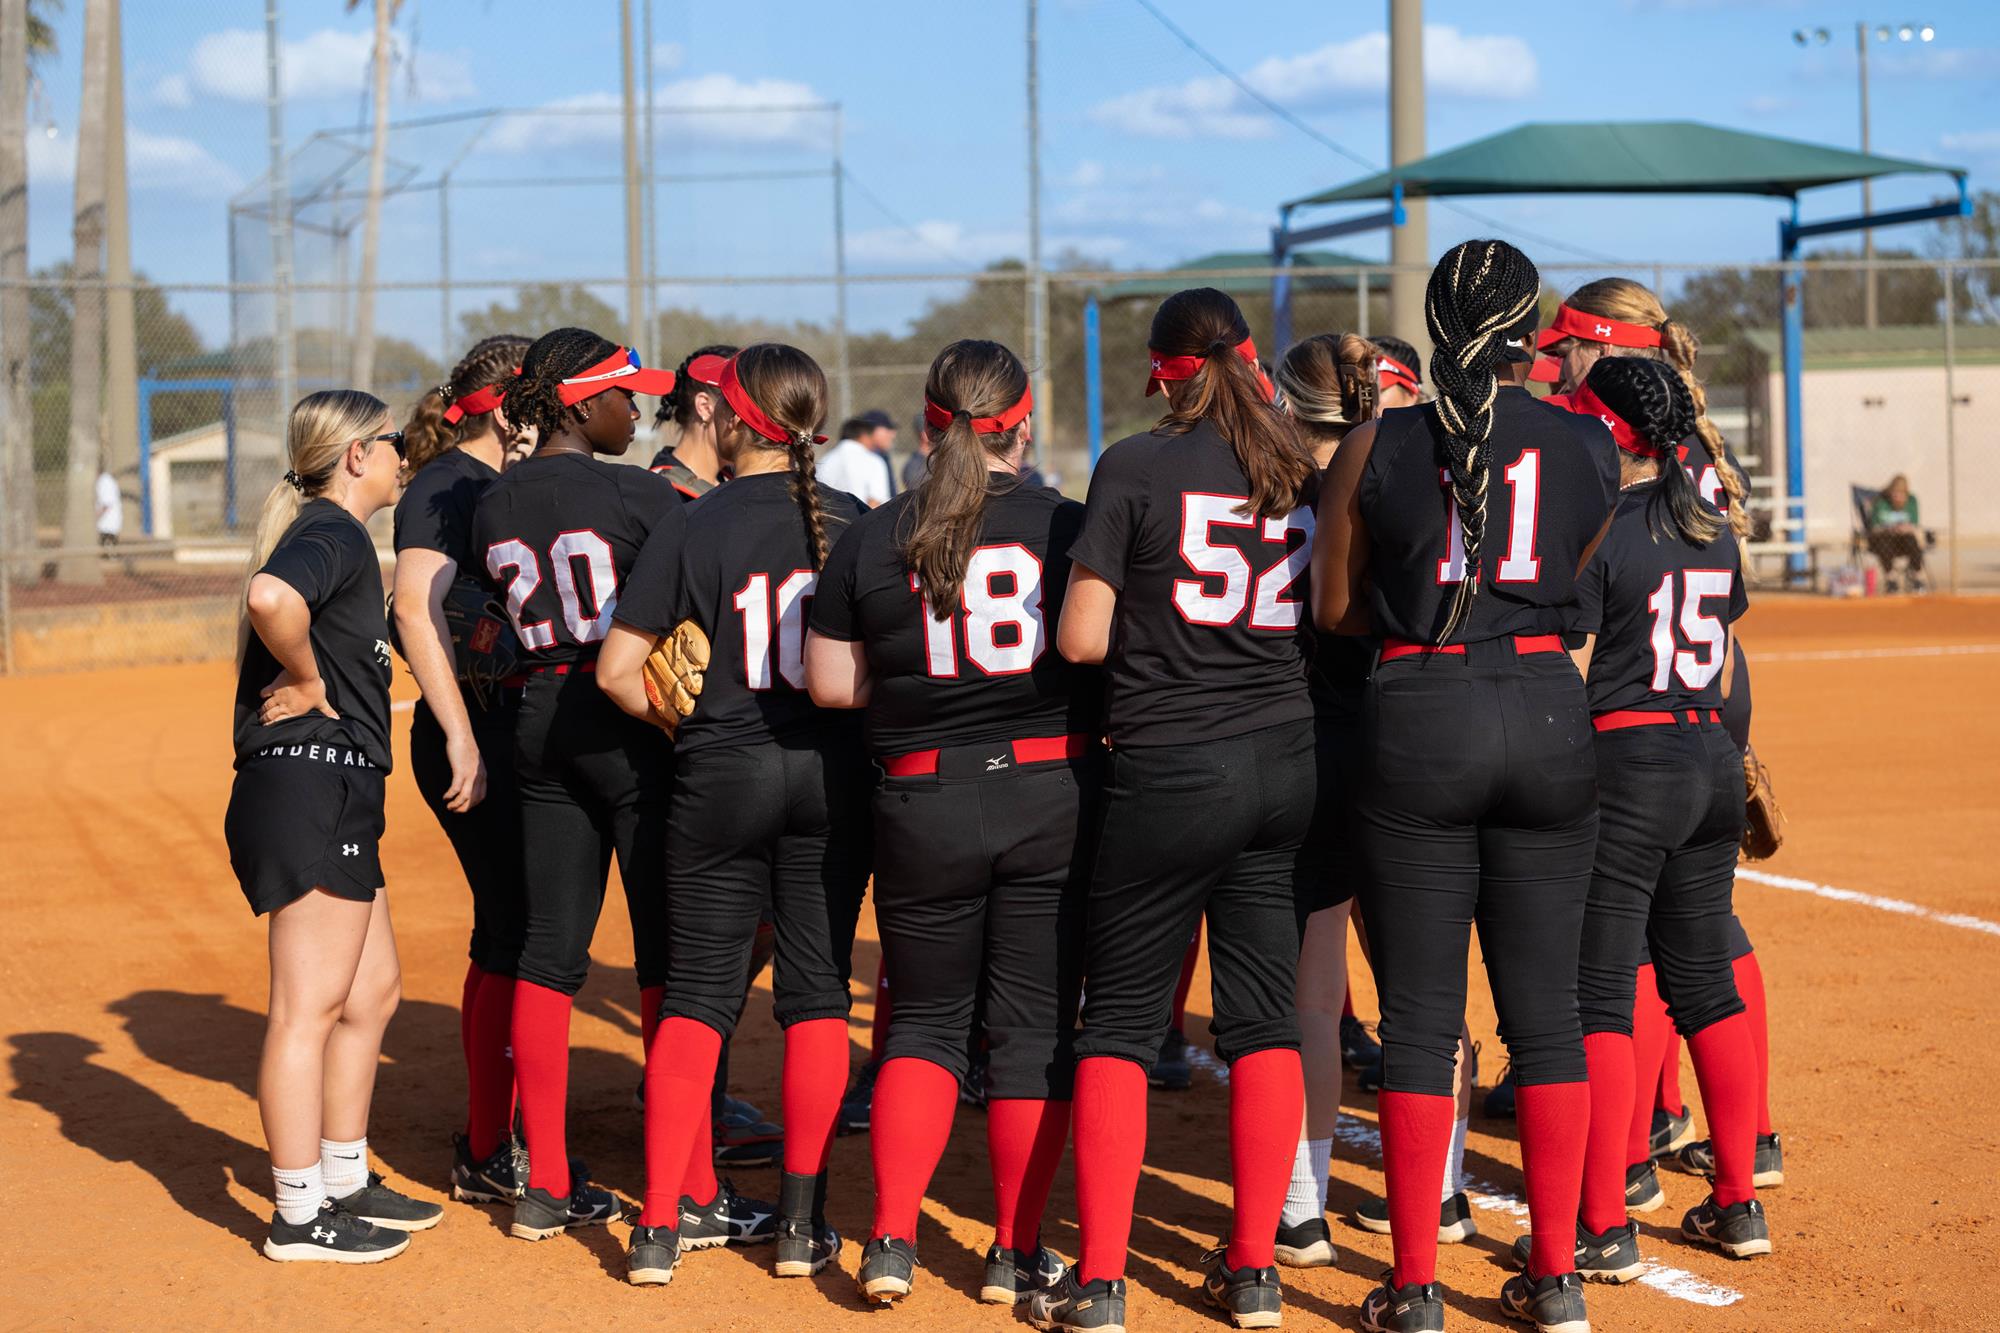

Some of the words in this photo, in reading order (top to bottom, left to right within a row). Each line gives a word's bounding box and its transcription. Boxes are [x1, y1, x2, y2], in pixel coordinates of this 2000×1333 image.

[486, 528, 619, 652] 20
[908, 542, 1048, 678] 18
[1171, 491, 1316, 630] 52
[1648, 568, 1733, 693] 15
